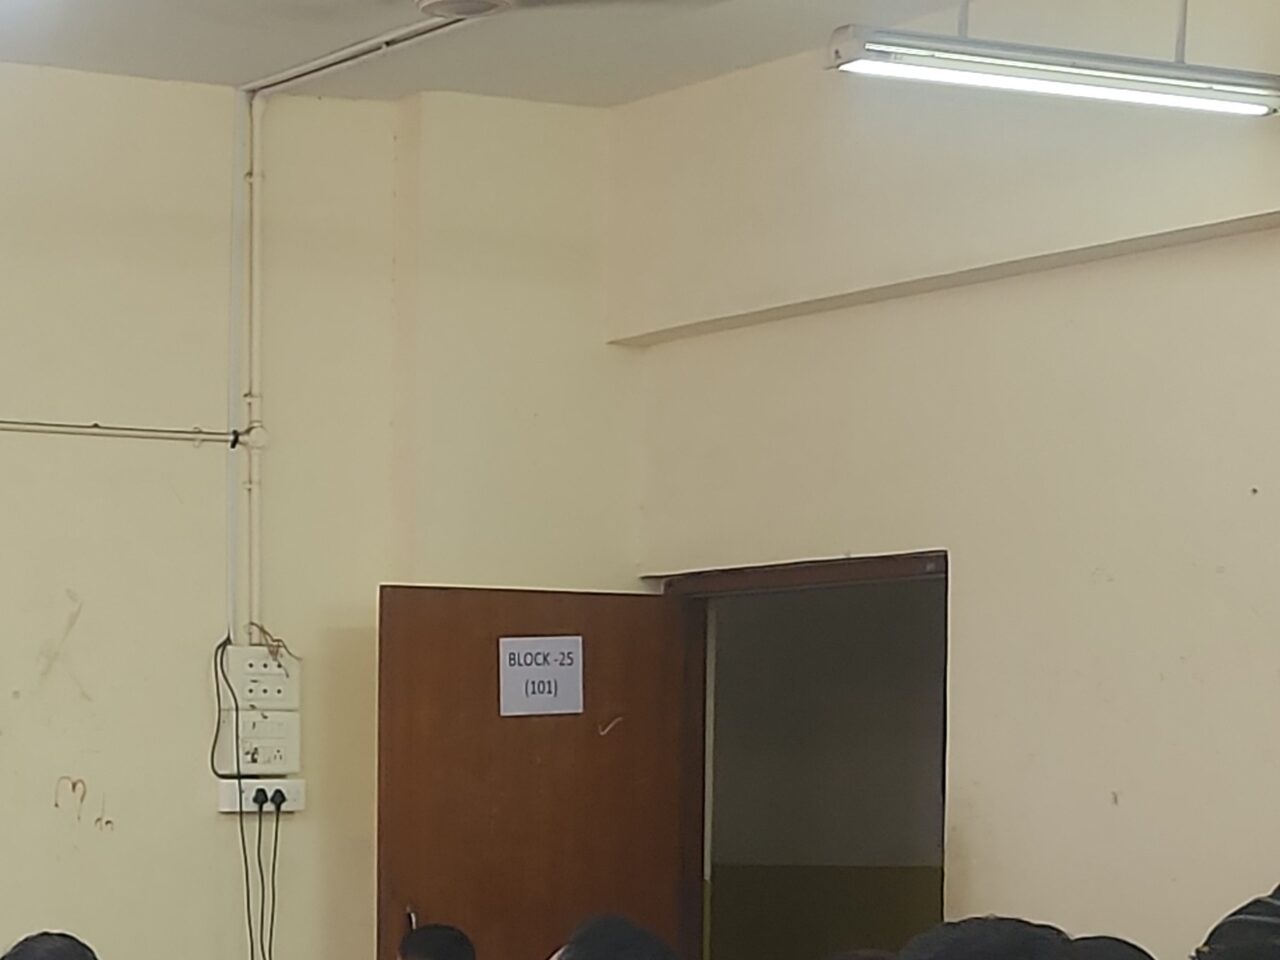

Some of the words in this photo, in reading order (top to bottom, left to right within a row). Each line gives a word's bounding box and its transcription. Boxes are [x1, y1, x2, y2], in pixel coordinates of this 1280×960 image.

[507, 651, 551, 668] BLOCK
[553, 650, 575, 667] -25
[524, 679, 559, 699] (101)
